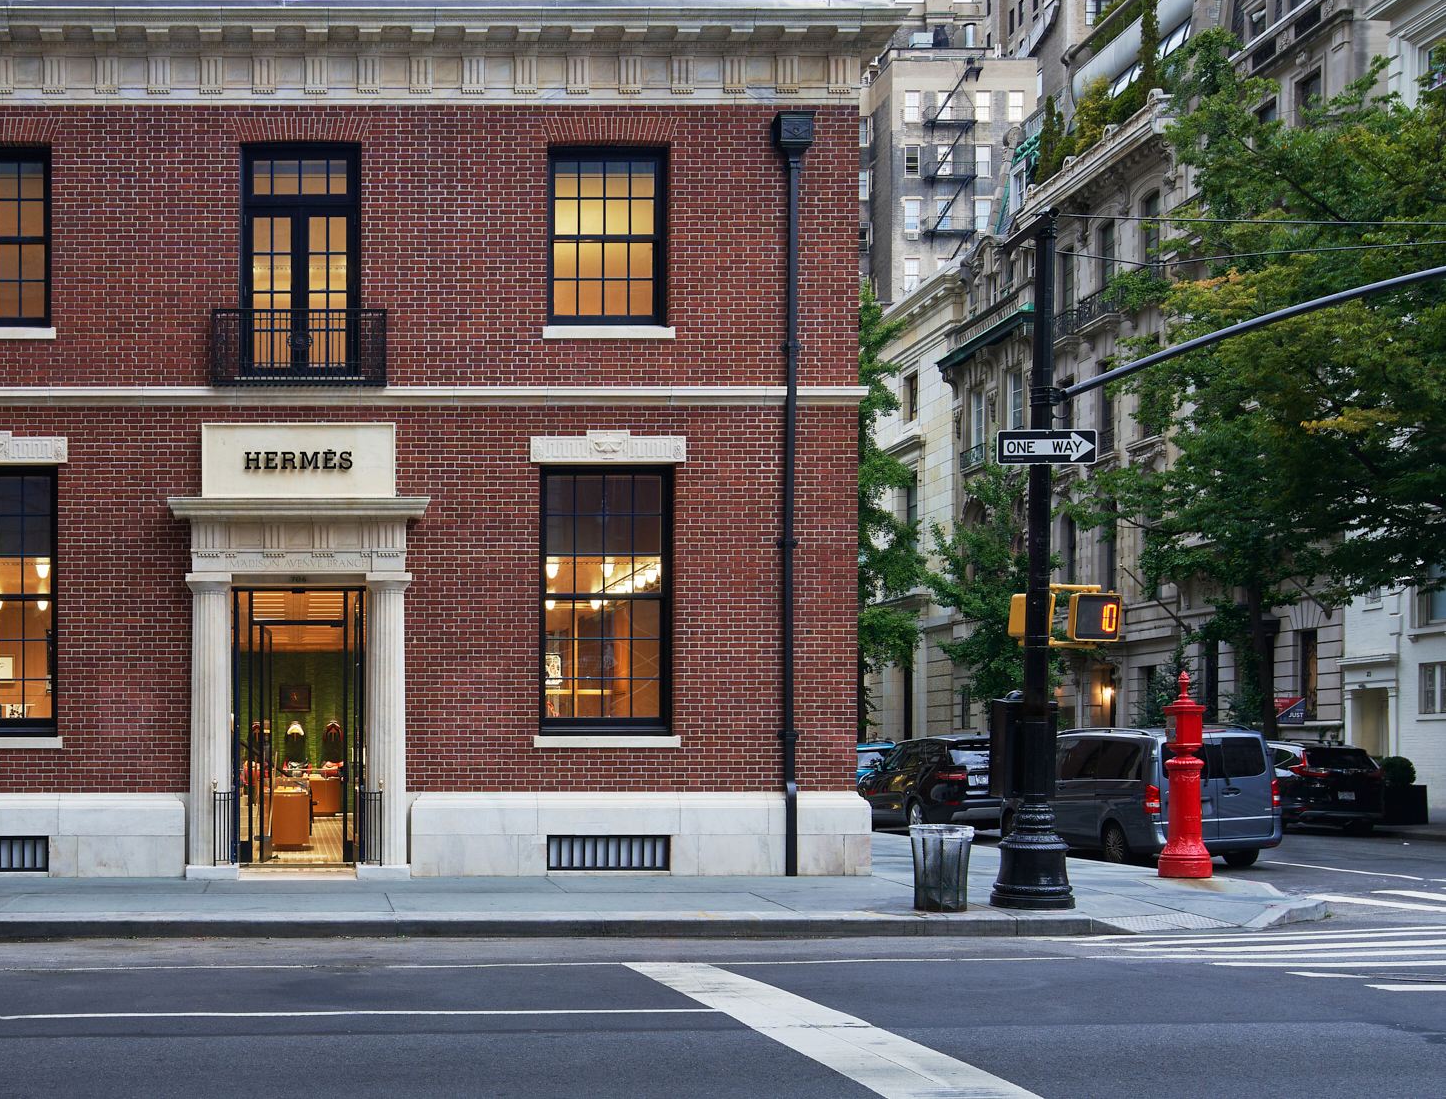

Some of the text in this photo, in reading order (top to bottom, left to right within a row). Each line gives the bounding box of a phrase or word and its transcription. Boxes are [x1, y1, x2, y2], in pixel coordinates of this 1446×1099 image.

[1007, 441, 1083, 454] ONE WAY
[244, 449, 353, 470] HERMÈS
[229, 558, 279, 568] MADISON
[327, 558, 369, 568] BRANCH
[1102, 604, 1117, 632] 10
